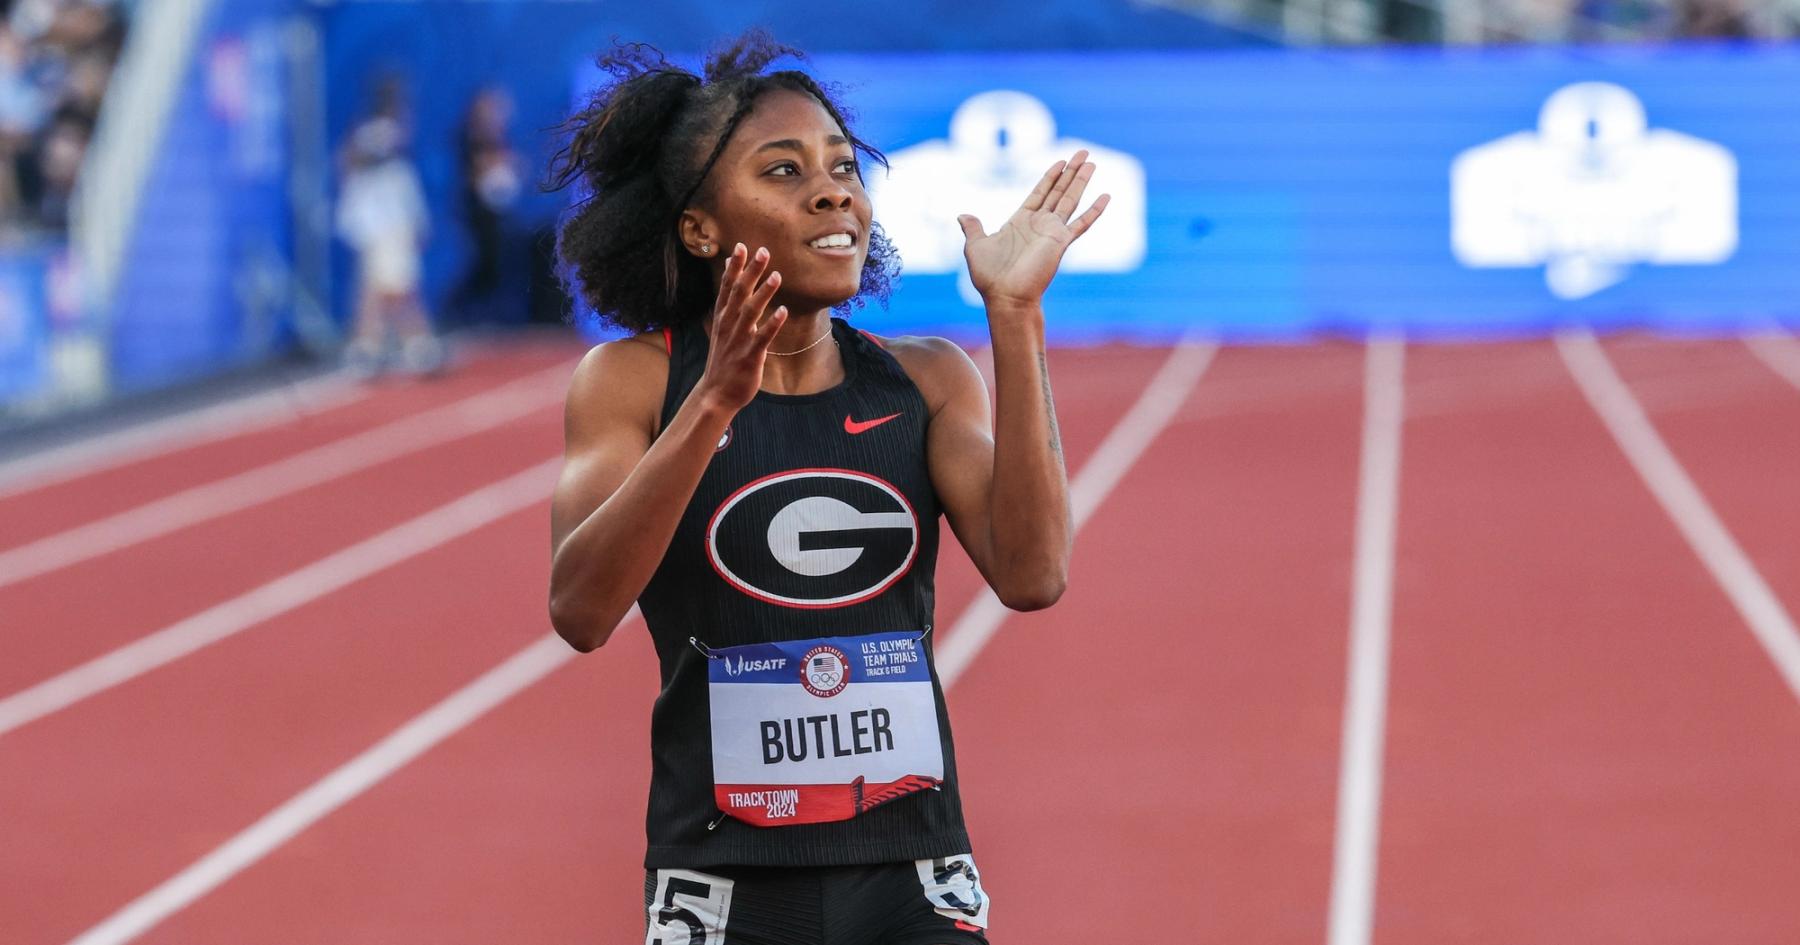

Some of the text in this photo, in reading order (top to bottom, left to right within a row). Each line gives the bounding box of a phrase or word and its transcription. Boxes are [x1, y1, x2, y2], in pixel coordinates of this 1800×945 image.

[712, 474, 915, 602] G
[861, 639, 915, 654] U.S. OLYMPIC
[744, 658, 787, 672] USATF
[863, 651, 918, 667] TEAM TRIALS
[866, 667, 885, 677] TRACK
[891, 665, 906, 675] FIELD
[759, 707, 895, 765] BUTLER
[728, 789, 799, 808] TRACKTOWN
[766, 803, 797, 819] 2024
[651, 876, 712, 945] 5
